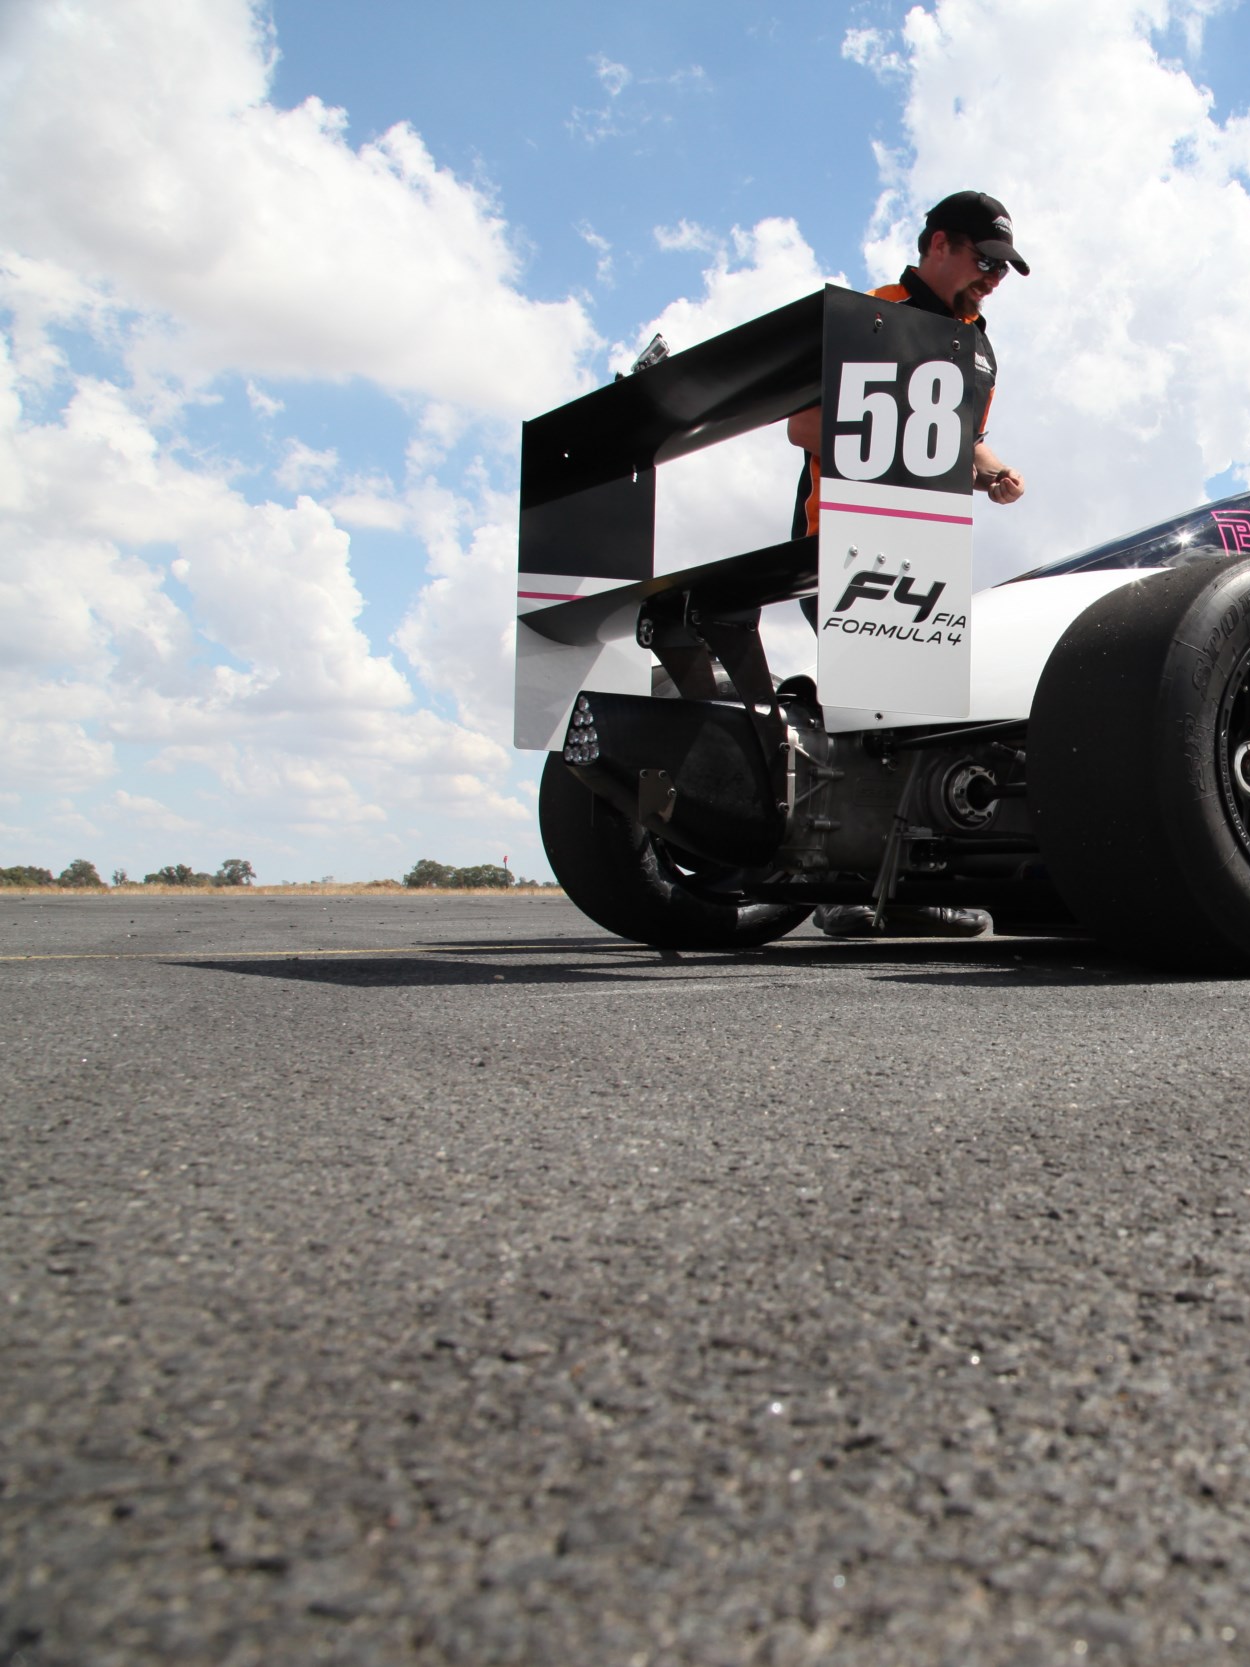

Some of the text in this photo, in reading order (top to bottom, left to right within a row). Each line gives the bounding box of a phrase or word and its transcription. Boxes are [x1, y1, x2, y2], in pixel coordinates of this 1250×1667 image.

[834, 361, 964, 480] 58
[833, 569, 967, 629] F4 FIA
[823, 617, 943, 645] FORMULA
